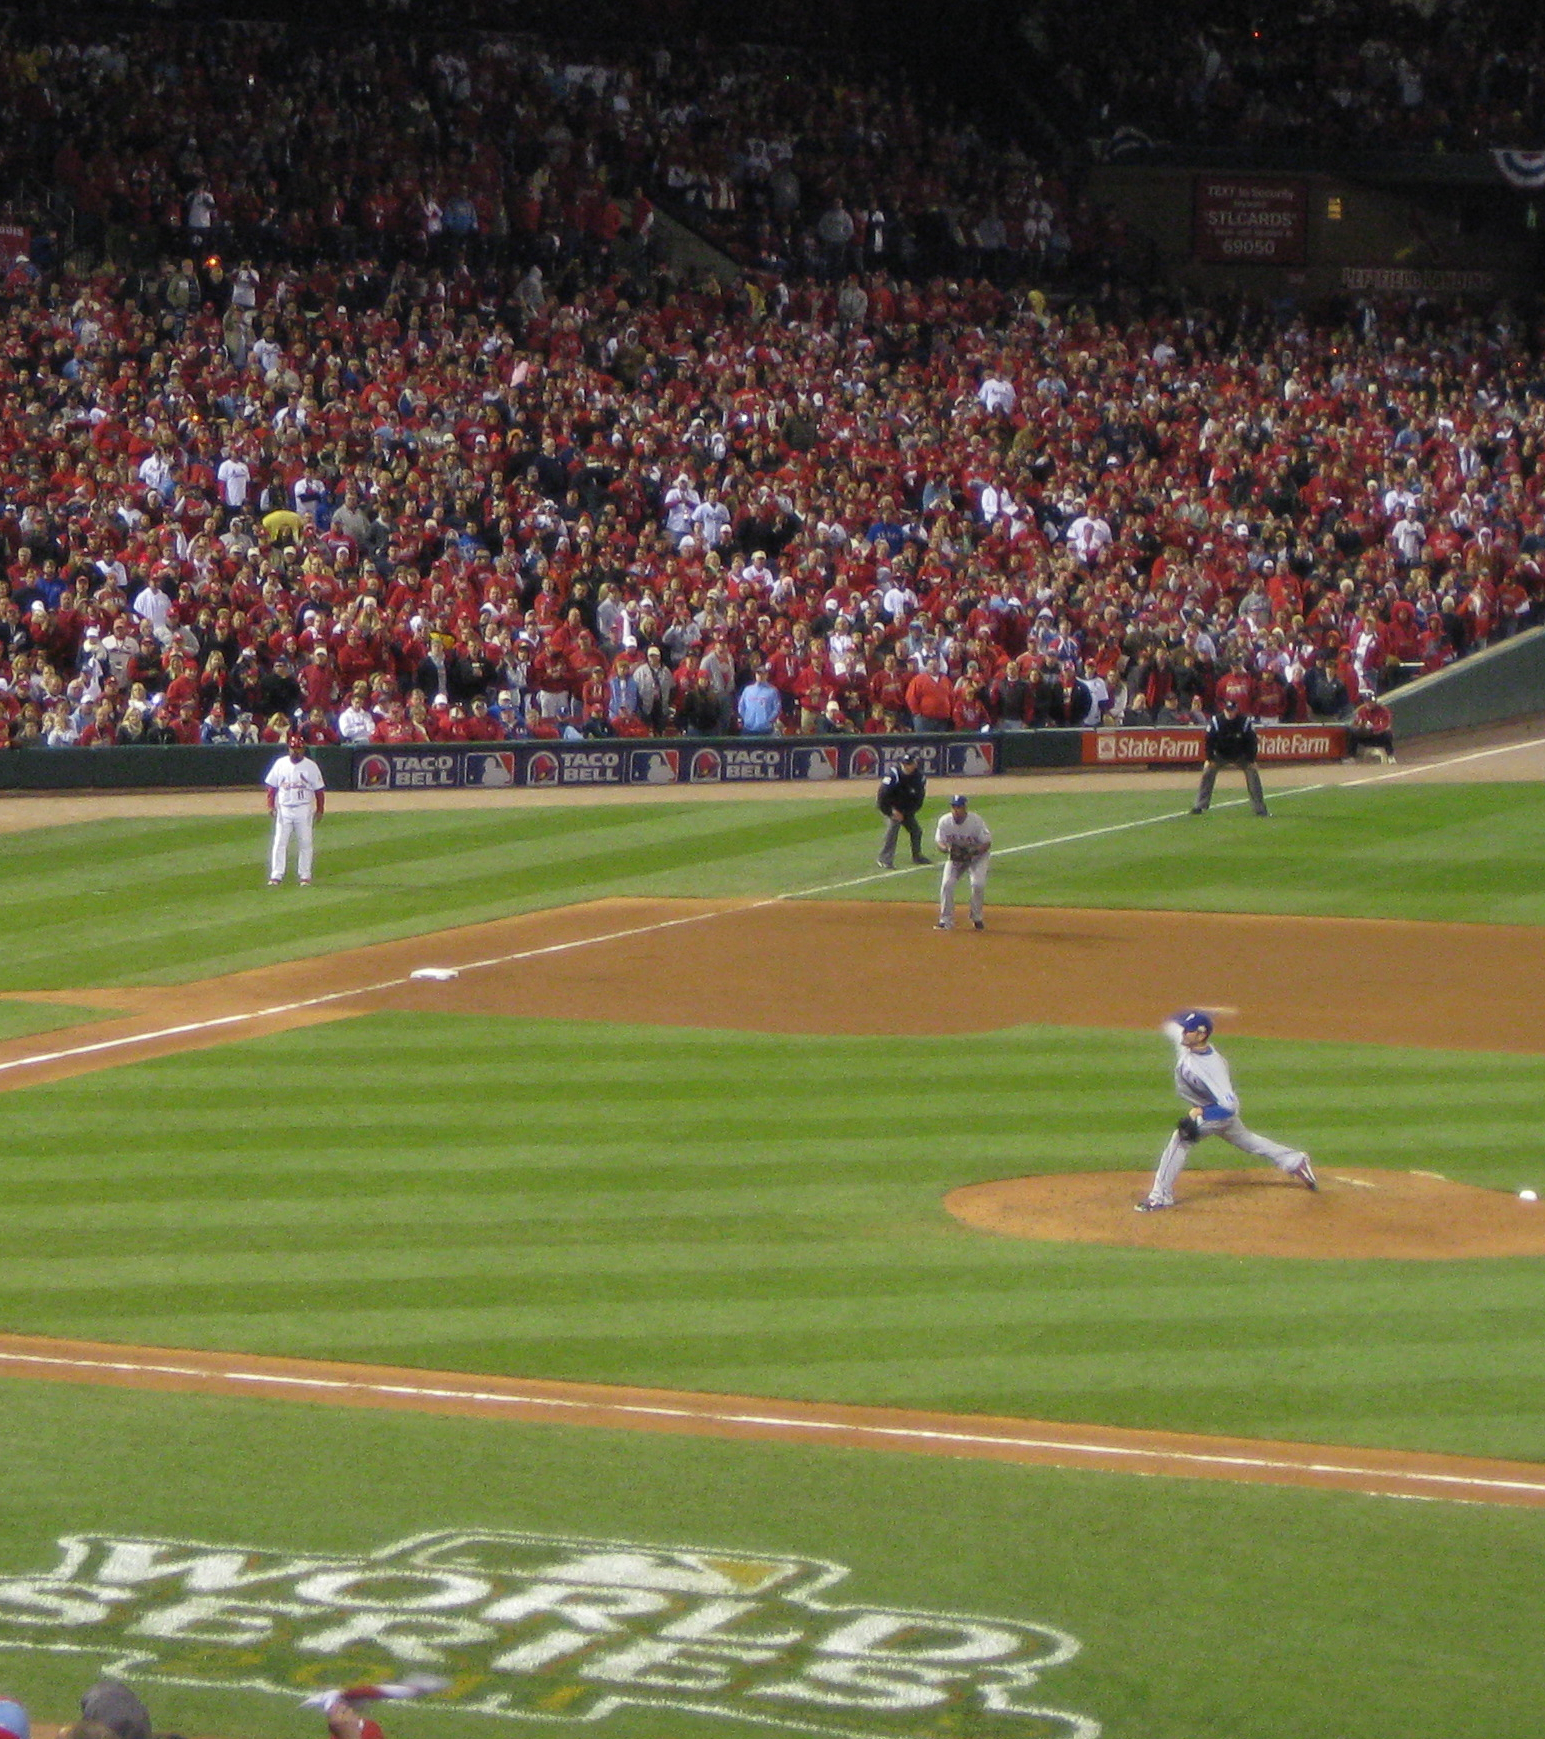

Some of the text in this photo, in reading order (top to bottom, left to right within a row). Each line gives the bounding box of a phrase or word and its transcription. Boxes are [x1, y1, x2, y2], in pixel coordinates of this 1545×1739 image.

[1222, 239, 1275, 255] 69050
[1116, 736, 1199, 758] State Farm
[1290, 733, 1330, 754] Farm
[393, 755, 454, 771] TACO
[560, 752, 619, 767] TACO
[723, 749, 781, 765] TACO
[394, 771, 454, 786] BELL
[563, 767, 619, 782] BELL
[725, 765, 780, 780] BELL
[96, 1542, 1024, 1662] WORLD
